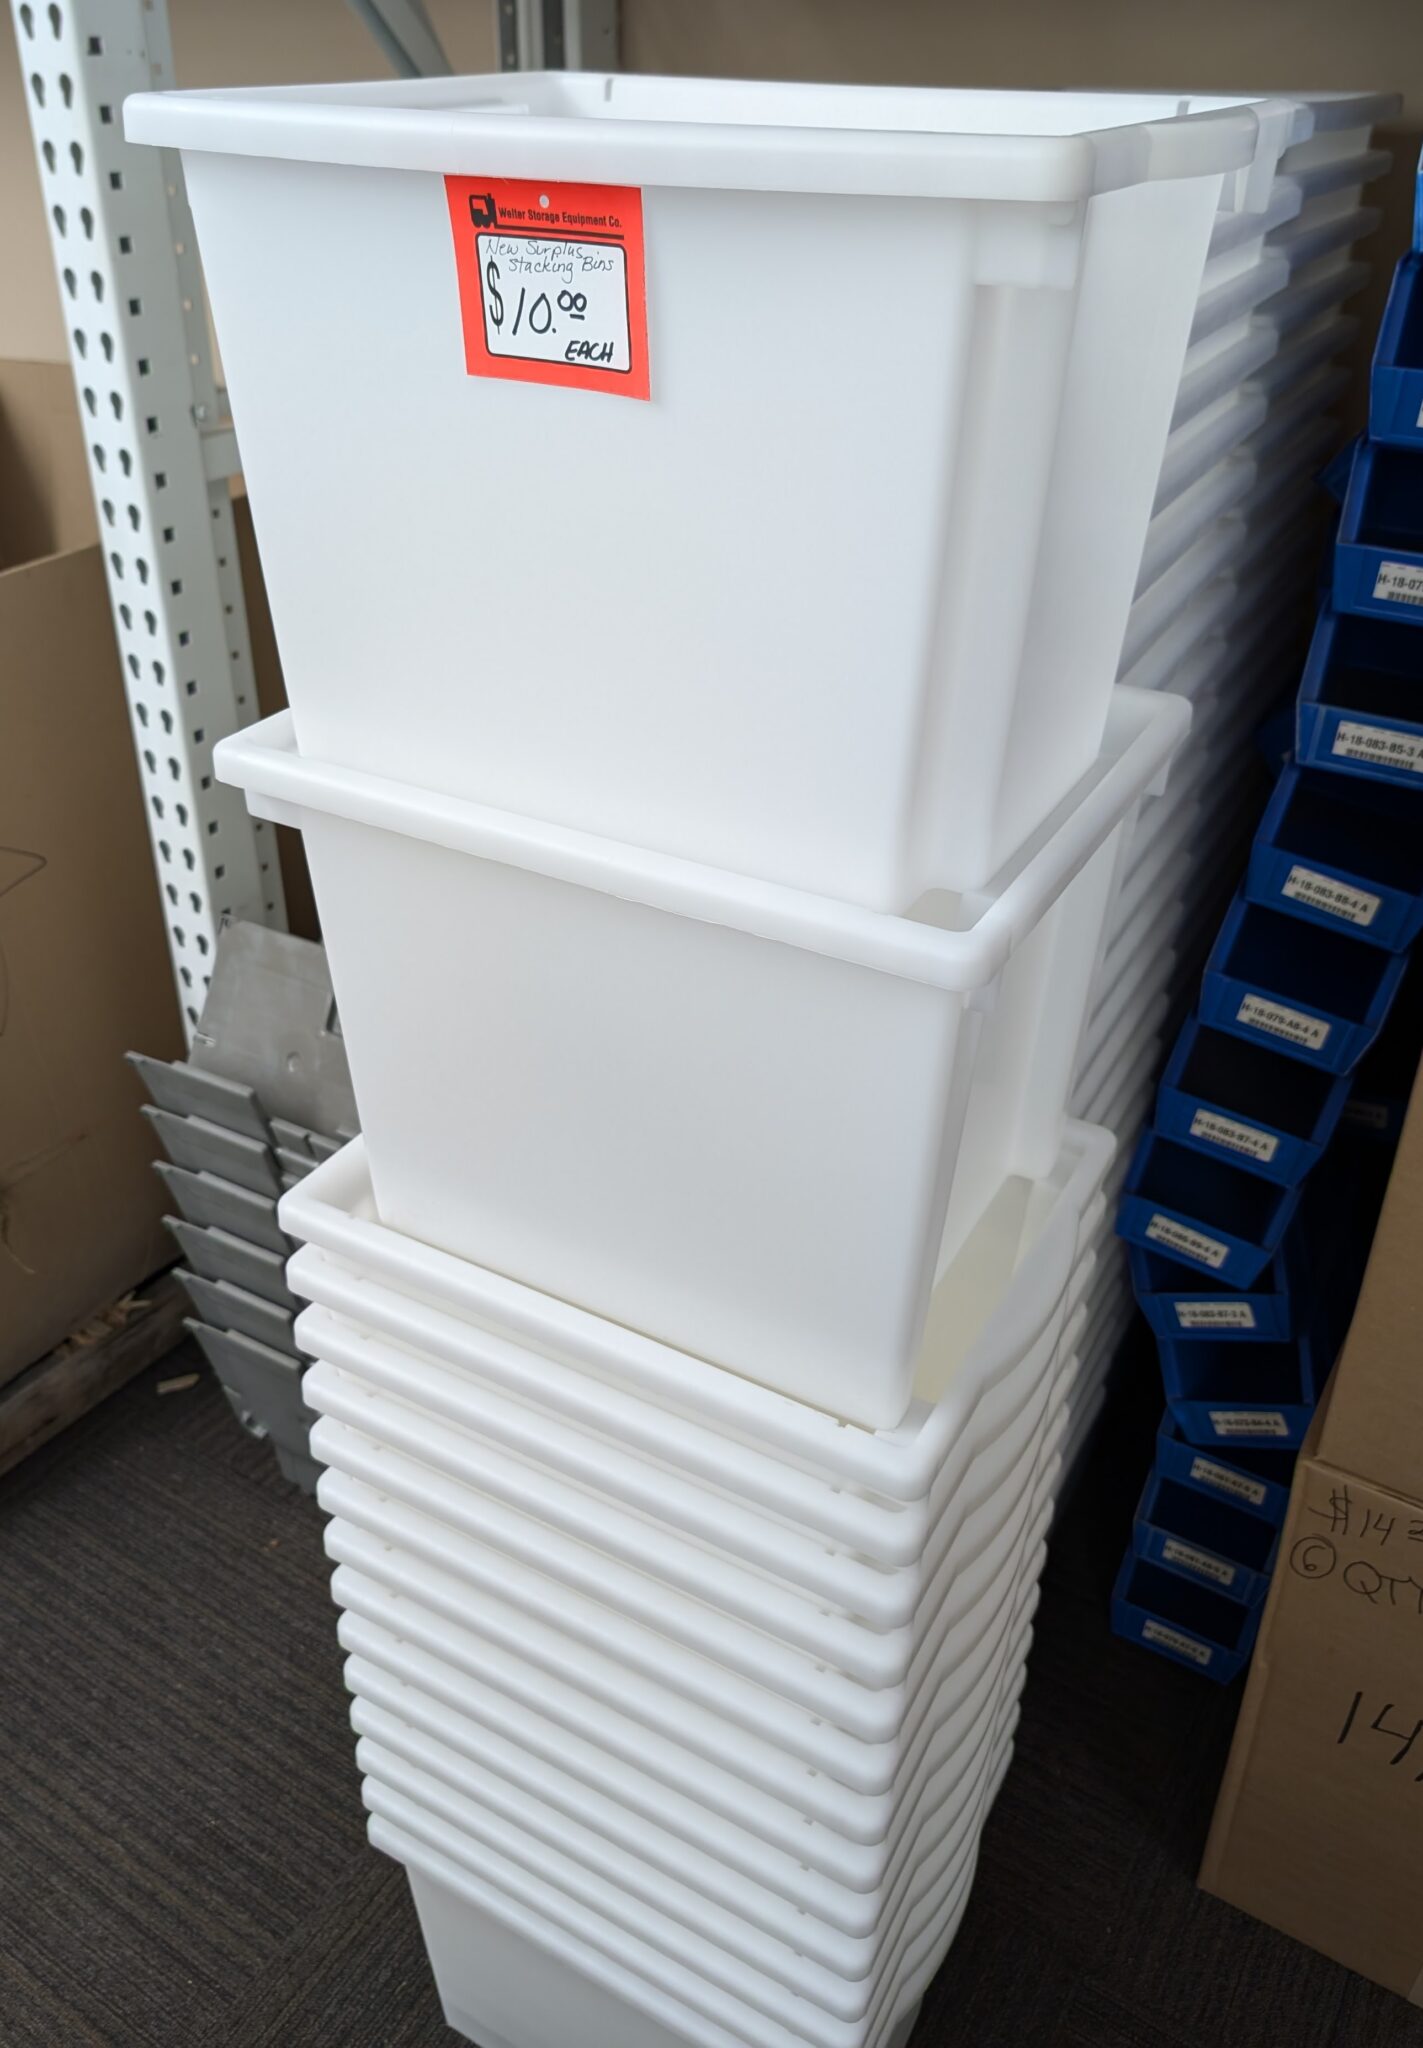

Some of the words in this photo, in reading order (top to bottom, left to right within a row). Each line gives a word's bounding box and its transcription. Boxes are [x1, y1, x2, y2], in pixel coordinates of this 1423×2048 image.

[498, 207, 525, 220] Welter
[528, 209, 560, 224] Storage
[562, 212, 606, 227] Equipment
[608, 216, 622, 228] Co.
[486, 236, 519, 256] New
[526, 240, 583, 261] Surplus
[581, 251, 614, 272] Bins
[565, 340, 614, 363] EACH
[1377, 573, 1423, 592] H-18-07
